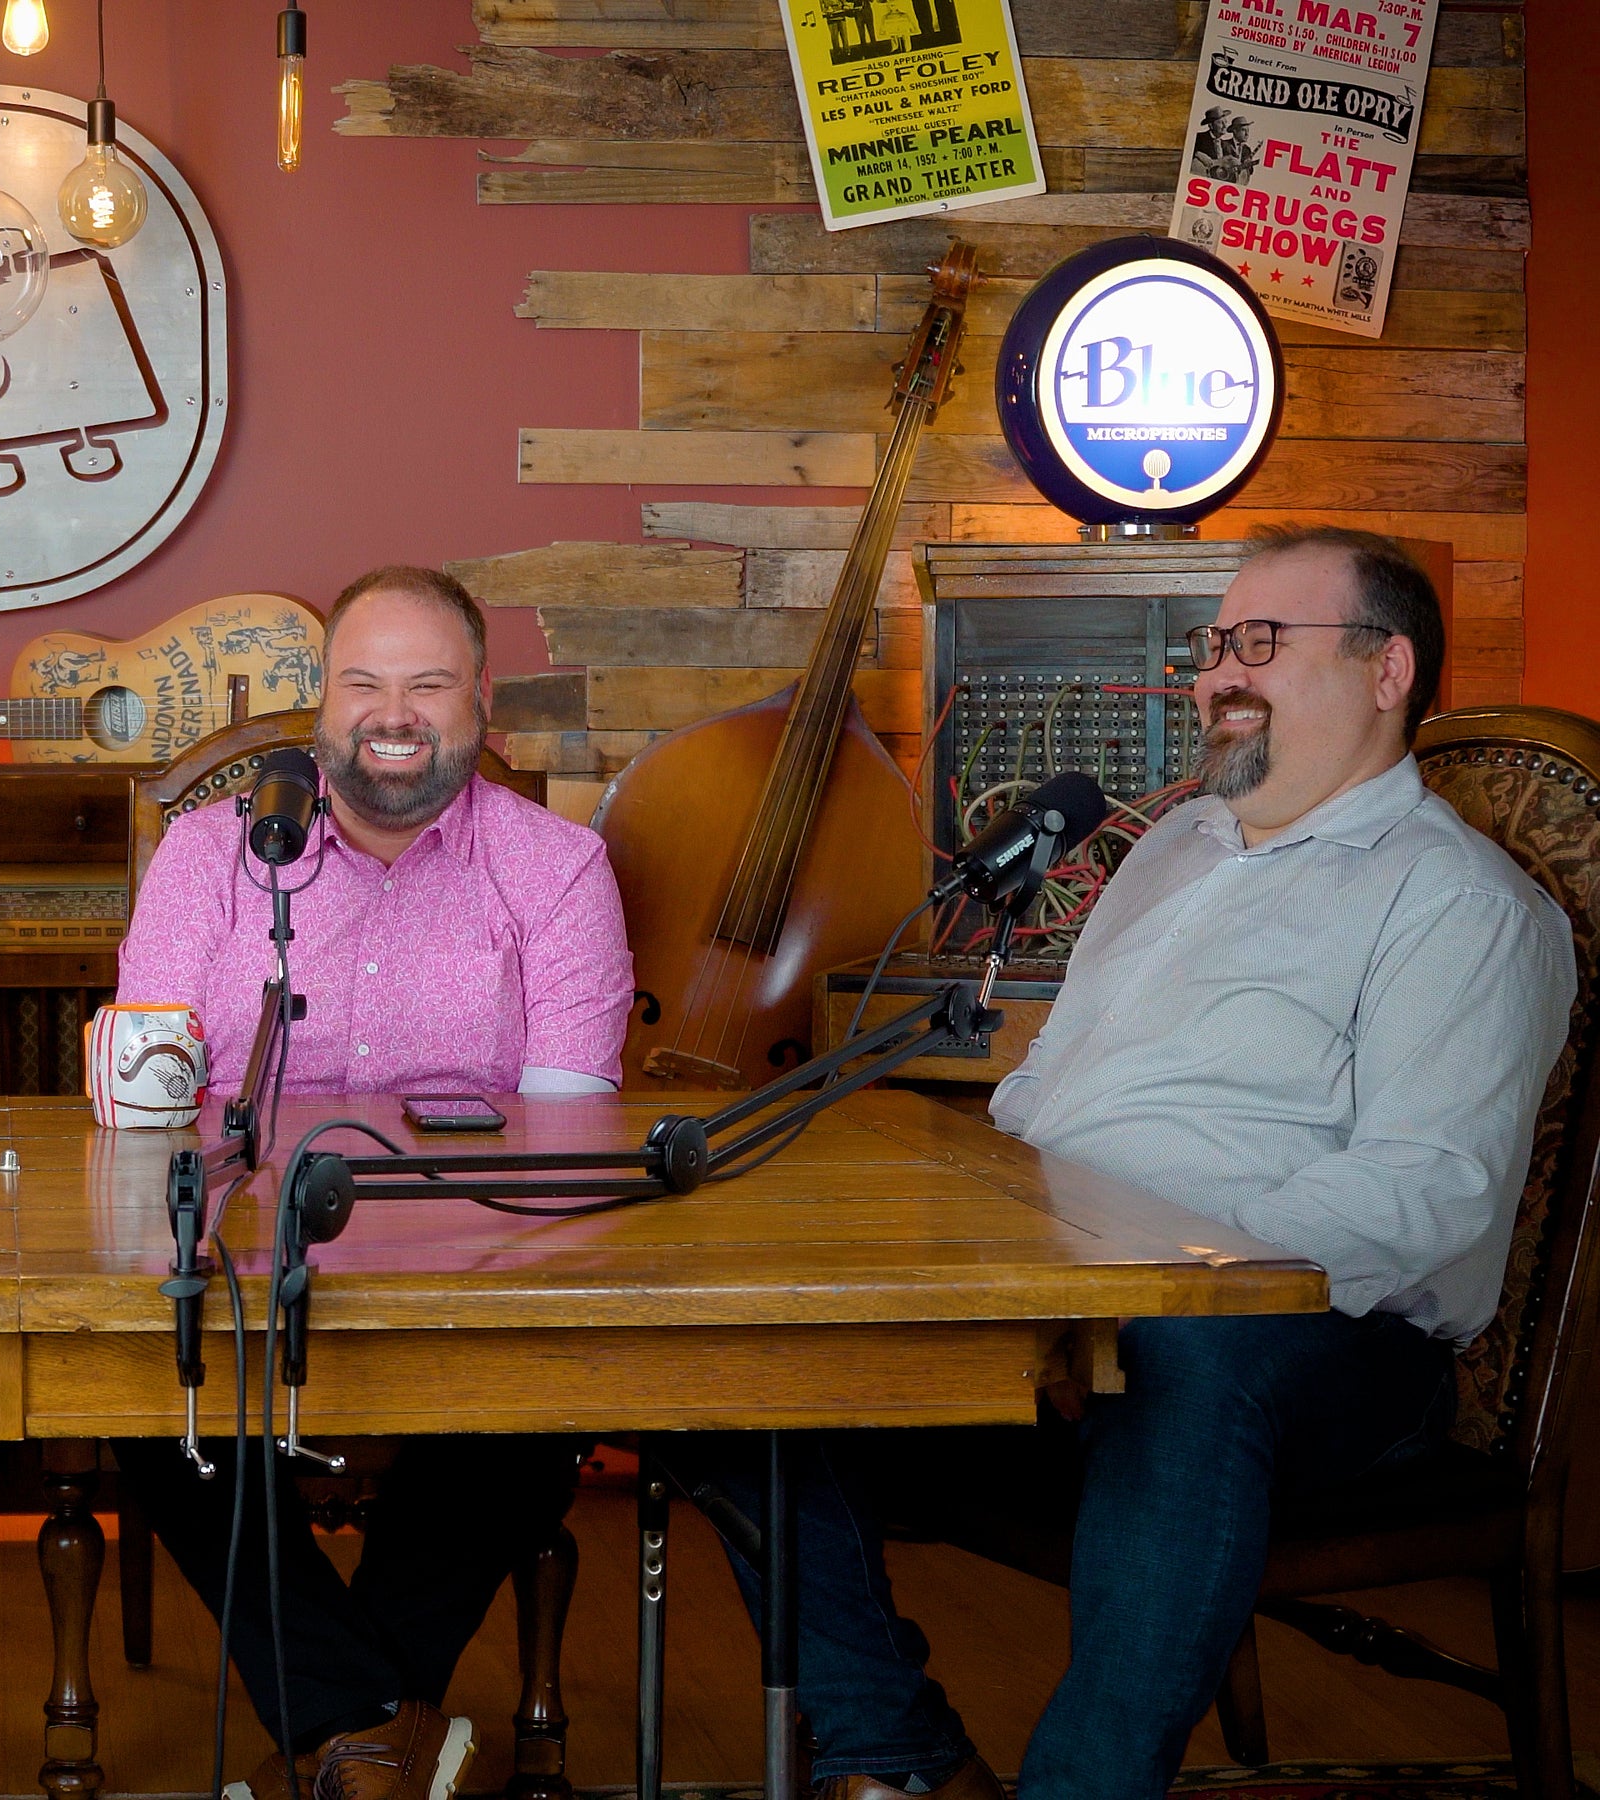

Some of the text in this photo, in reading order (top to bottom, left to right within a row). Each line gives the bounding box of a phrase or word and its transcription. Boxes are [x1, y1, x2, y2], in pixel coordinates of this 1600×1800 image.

[1222, 0, 1422, 47] RI. MAR. 7
[1248, 16, 1285, 33] ADULTS
[1326, 33, 1370, 53] CHILDREN
[1372, 44, 1388, 58] 6-11
[1390, 48, 1417, 63] $1.00
[867, 51, 944, 71] ALSO APPEARING
[1231, 26, 1400, 74] SPONSORED BY AMERICAN LEGION
[1248, 55, 1297, 72] Direct From
[817, 51, 1000, 96] RED FOLEY
[909, 75, 959, 91] SHOESHINE
[821, 80, 1011, 123] LES PAUL & MARY FORD
[1213, 67, 1411, 129] GRAND OLE OPRY
[827, 117, 1022, 166] MINNIE PEARL
[1320, 132, 1360, 151] THE
[1334, 124, 1375, 140] In Person
[843, 158, 1016, 203] GRAND THEATER
[856, 160, 893, 177] MARCH
[897, 157, 912, 170] 14,
[915, 153, 938, 167] 1952
[953, 146, 972, 160] 7:00
[1262, 139, 1398, 193] FLATT
[933, 185, 972, 199] GEORGIA
[1185, 178, 1388, 245] SCRUGGS
[1310, 184, 1352, 203] AND
[1221, 218, 1340, 267] SHOW
[1271, 295, 1282, 303] TV
[1293, 300, 1325, 314] MARTHA
[1327, 307, 1349, 318] WHITE
[1351, 313, 1371, 323] MILLS
[1080, 336, 1235, 409] Blue
[1086, 427, 1228, 441] MICROPHONES
[159, 636, 203, 749] SERENADE
[151, 675, 176, 764] NDOWN
[995, 834, 1035, 868] SHURE
